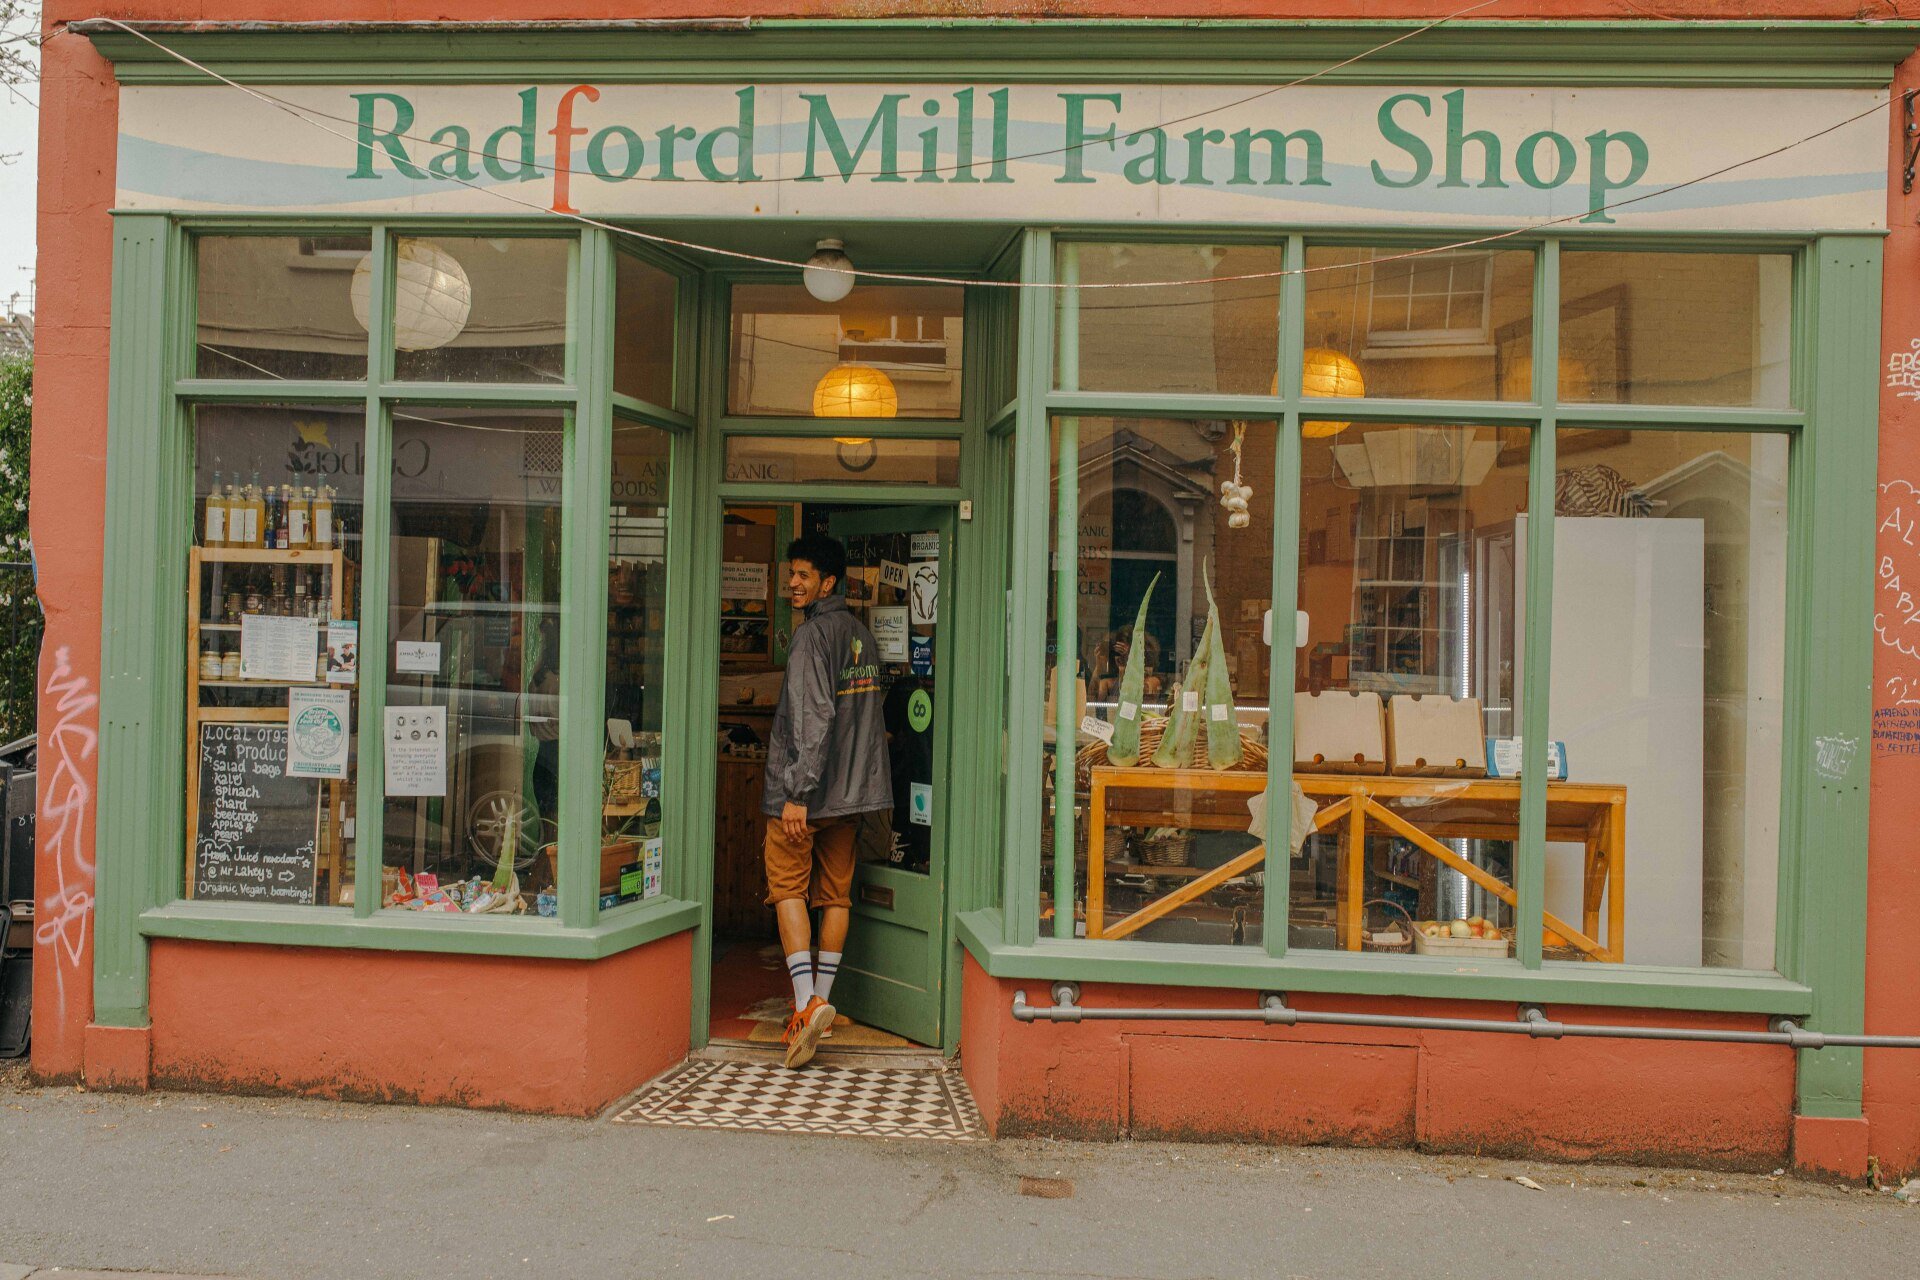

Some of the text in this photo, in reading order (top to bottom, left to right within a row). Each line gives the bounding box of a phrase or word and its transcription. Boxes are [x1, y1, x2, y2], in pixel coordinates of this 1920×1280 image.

[347, 84, 1650, 224] Radford Mill Farm Shop
[727, 463, 779, 480] GANIC
[911, 541, 940, 552] ORGANIC
[884, 564, 904, 584] OPEN
[1078, 581, 1107, 597] CES
[235, 743, 288, 761] Produc
[1887, 743, 1920, 754] BETTE
[212, 759, 246, 773] salad
[252, 761, 282, 779] bags
[214, 785, 261, 800] spinach
[214, 807, 259, 824] beetroot
[211, 819, 255, 834] Apples &
[199, 843, 231, 868] fresh
[233, 846, 259, 863] Juice
[207, 866, 218, 879] @
[220, 865, 234, 877] Mr
